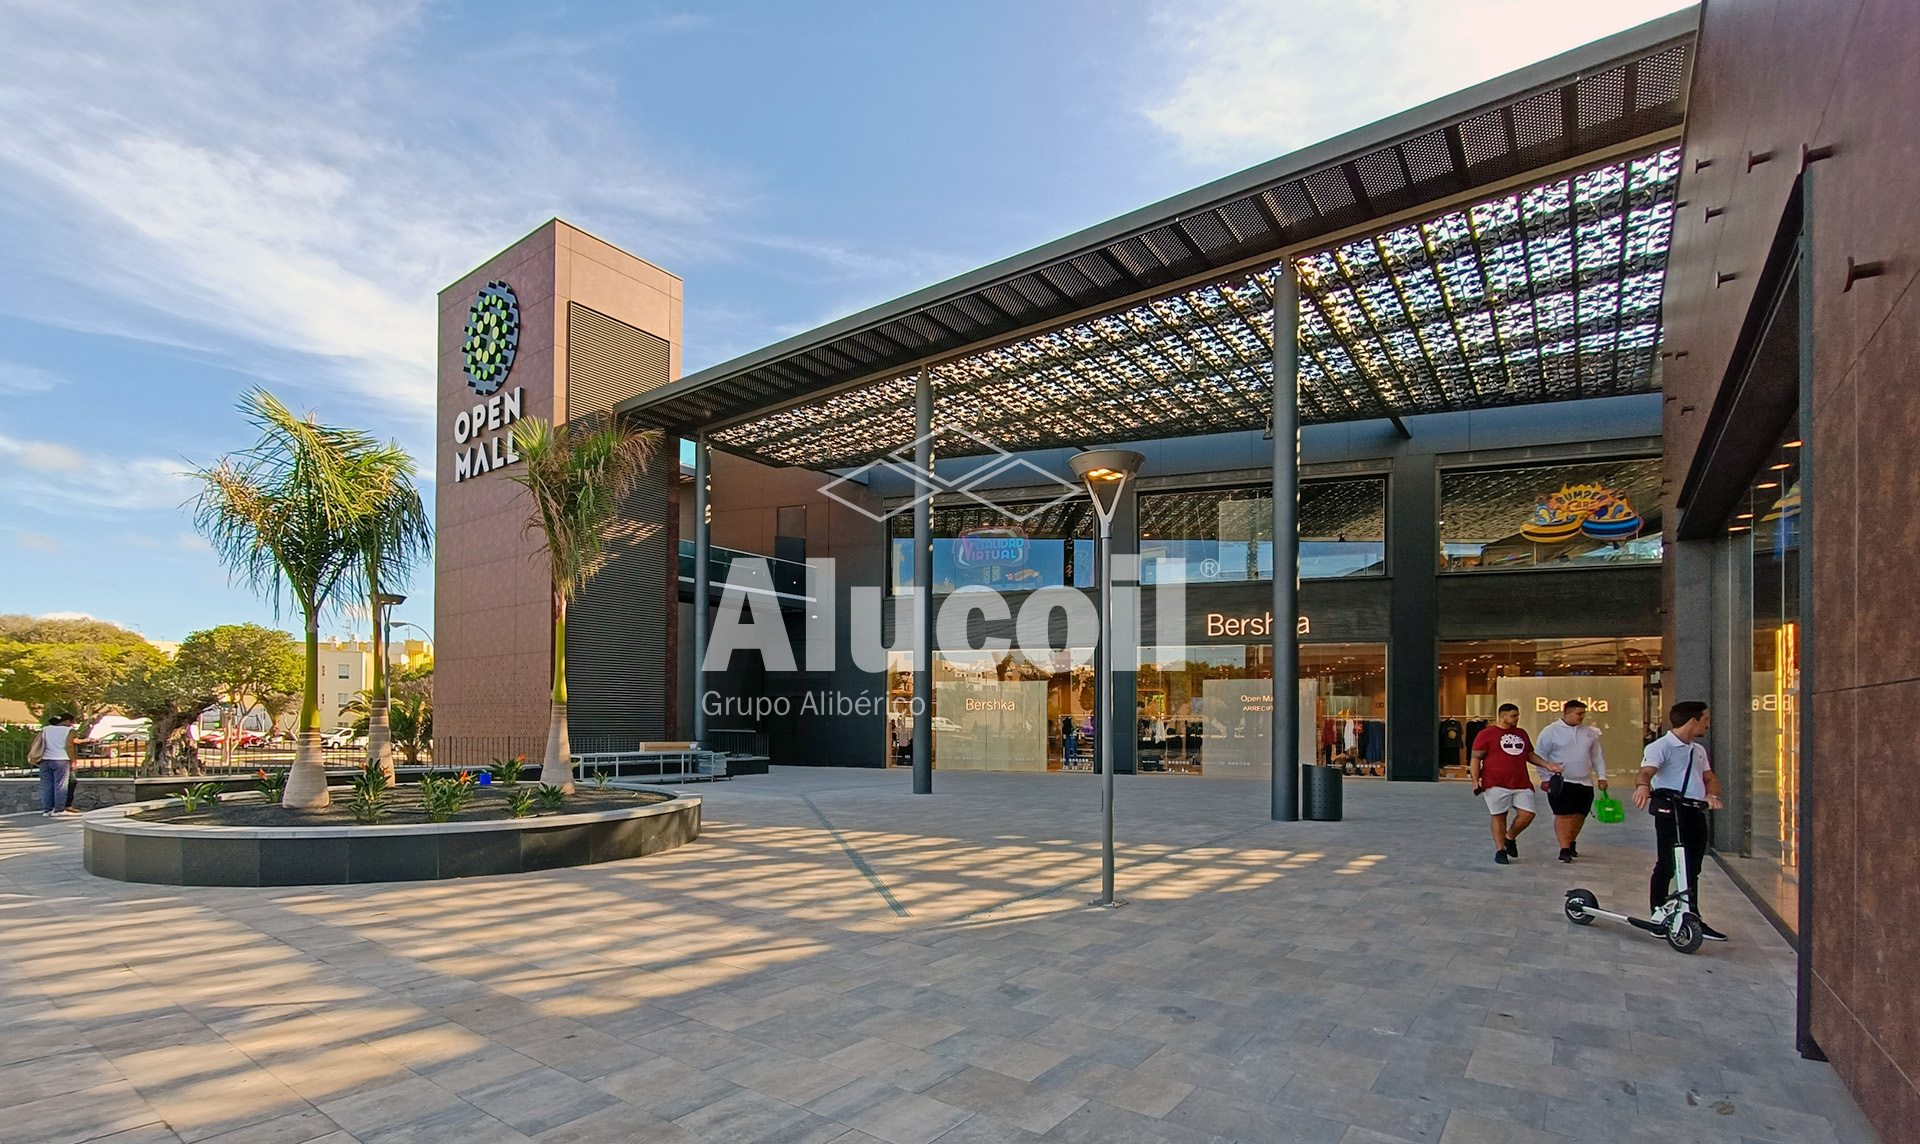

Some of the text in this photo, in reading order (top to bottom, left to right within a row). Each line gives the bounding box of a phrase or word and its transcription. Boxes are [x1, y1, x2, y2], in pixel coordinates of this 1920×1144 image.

[454, 386, 522, 444] OPEN
[455, 430, 521, 483] MALL
[961, 535, 1017, 561] VIRTUAL
[1207, 611, 1311, 637] Bersha
[965, 697, 1016, 711] Bershka
[1240, 694, 1262, 703] Open
